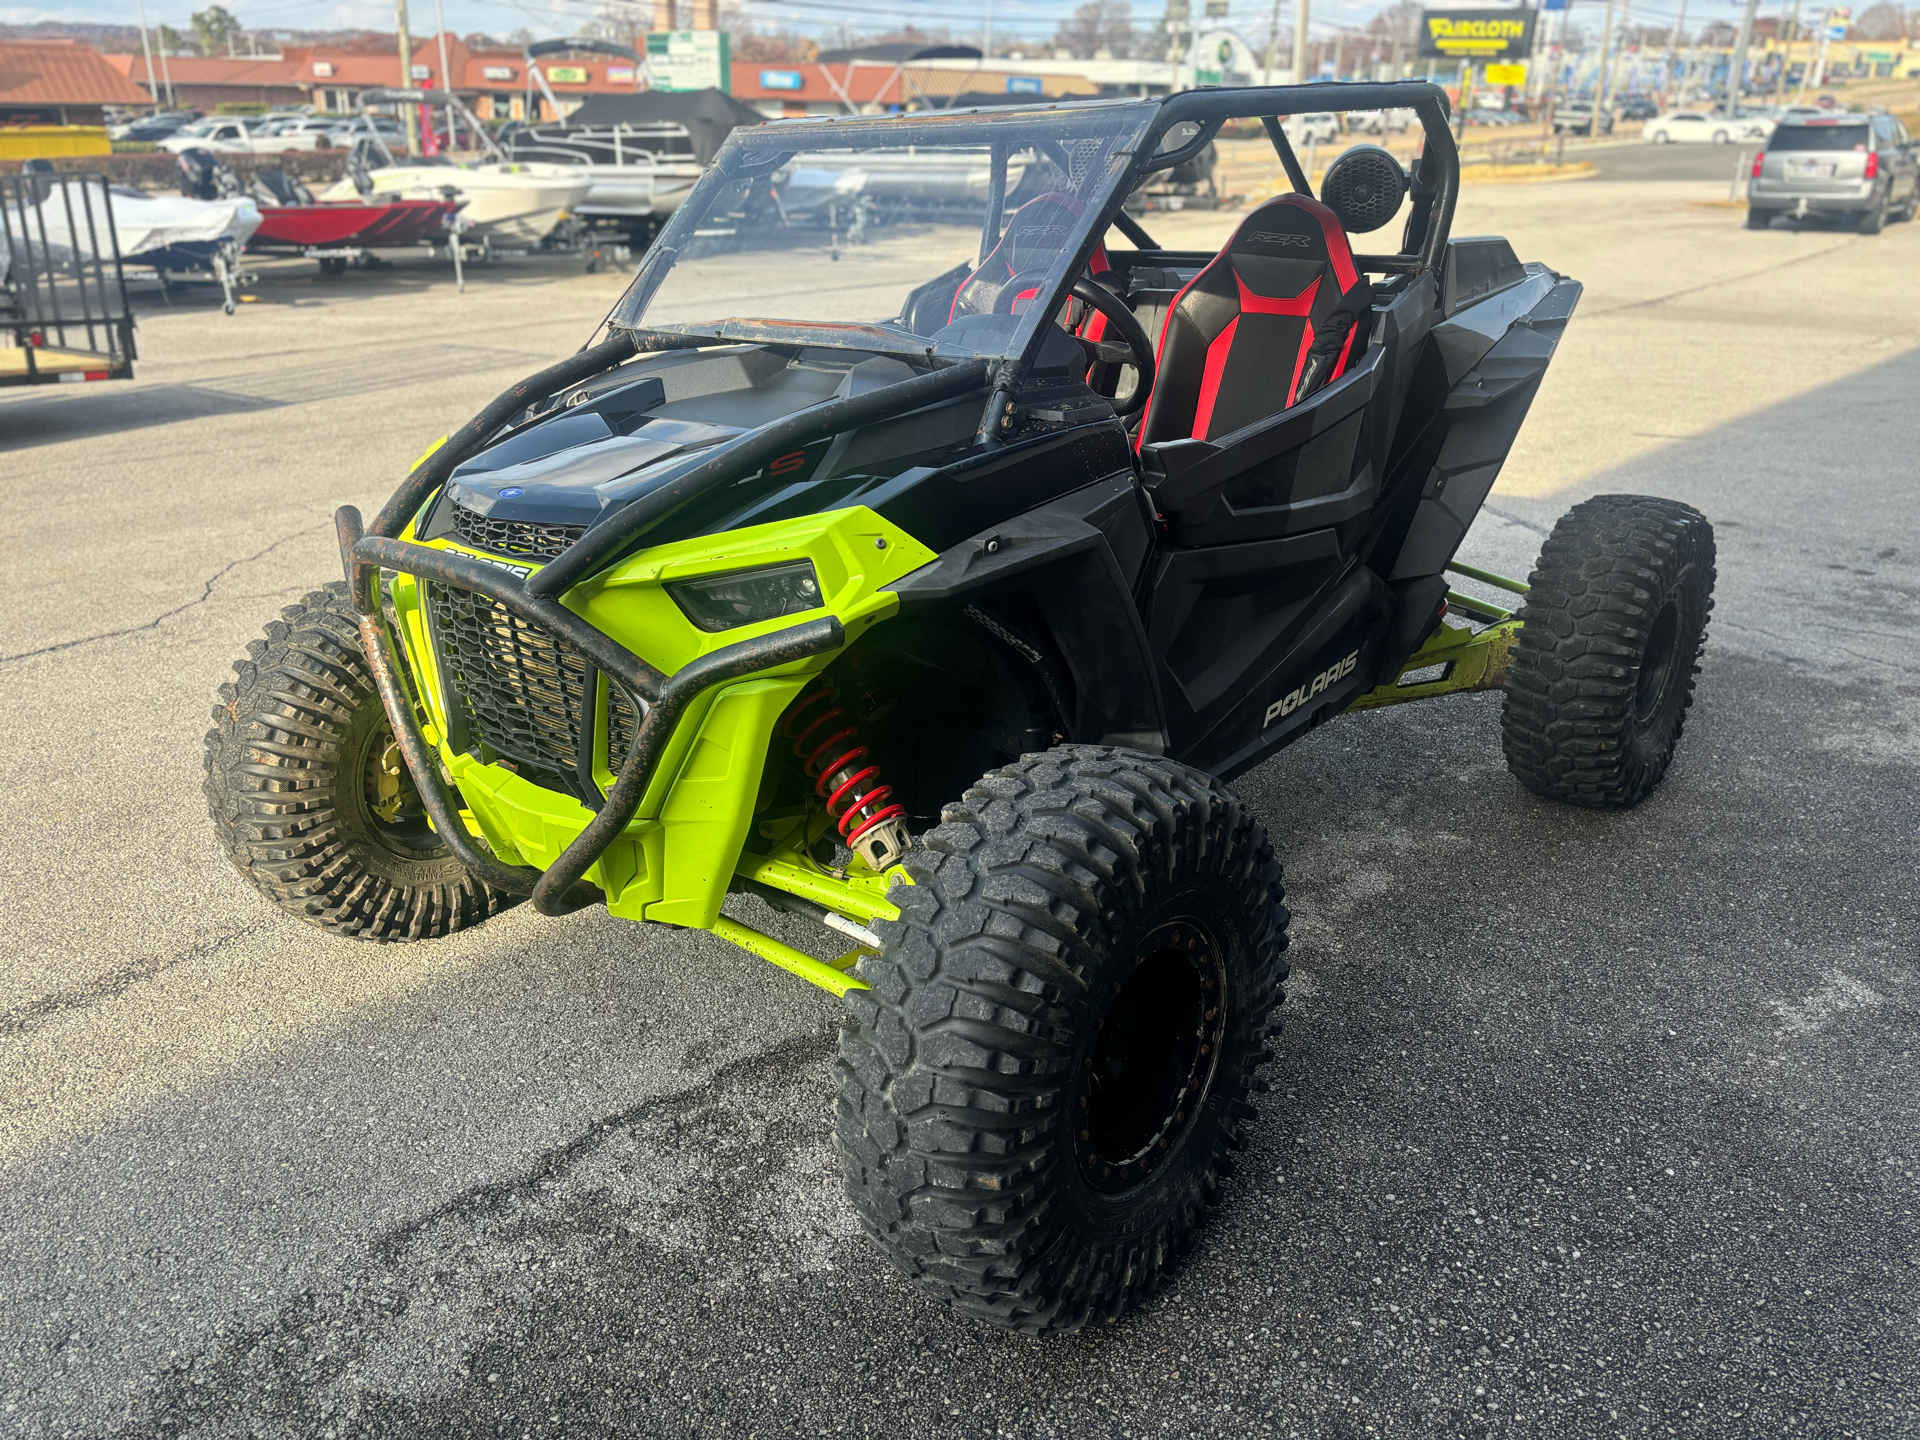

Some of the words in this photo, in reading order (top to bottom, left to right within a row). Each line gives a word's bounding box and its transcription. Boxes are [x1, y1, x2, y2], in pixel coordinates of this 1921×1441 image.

[1428, 18, 1525, 38] FAIRCLOTH
[1247, 230, 1311, 248] RZR
[1262, 648, 1359, 730] POLARIS
